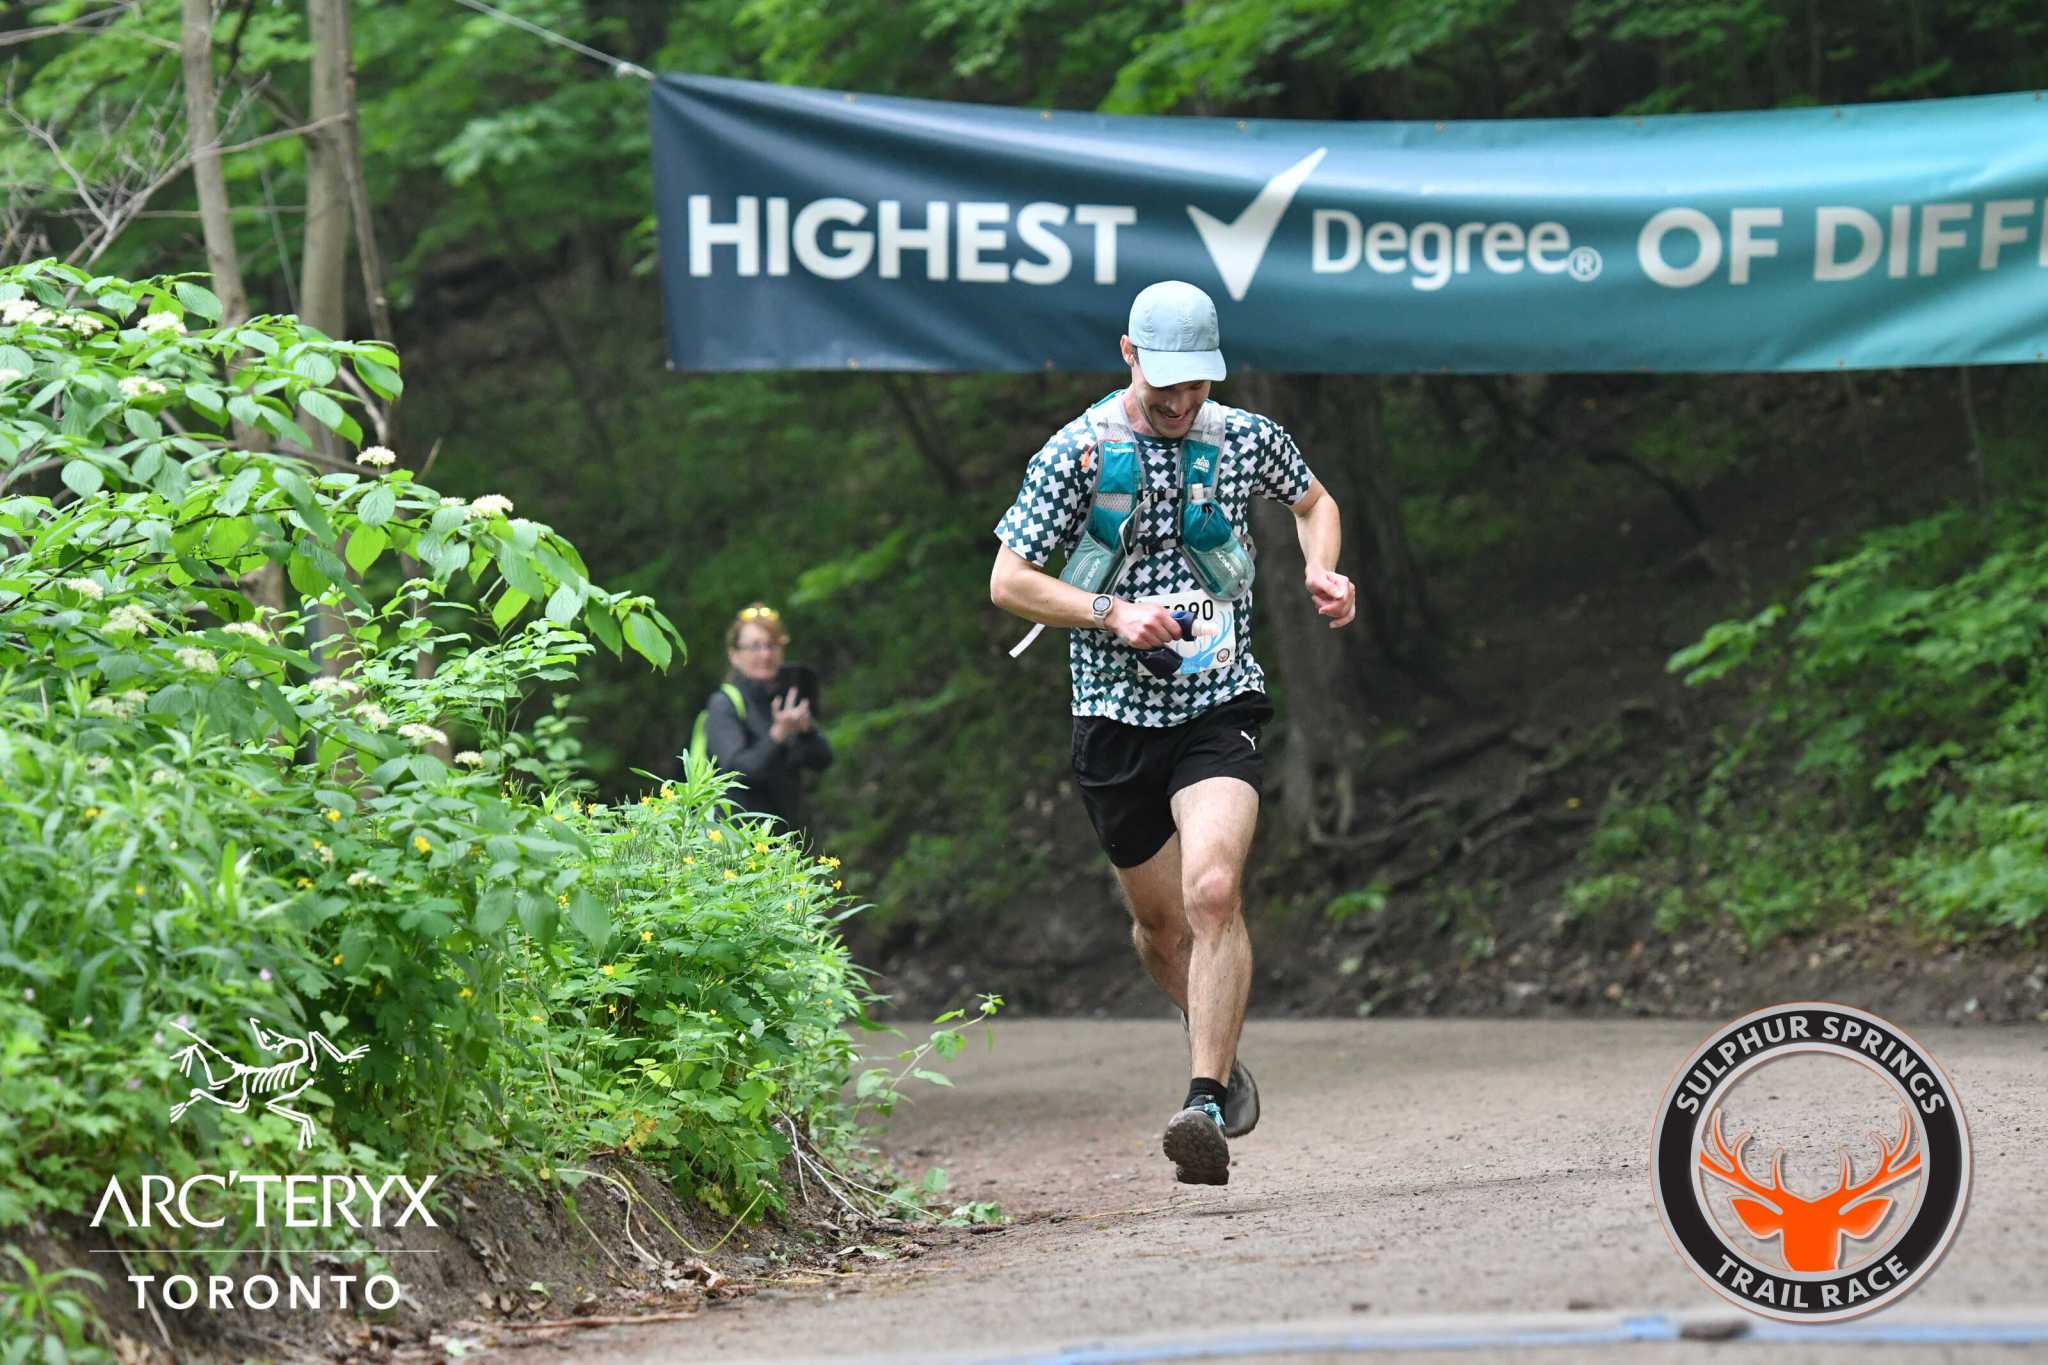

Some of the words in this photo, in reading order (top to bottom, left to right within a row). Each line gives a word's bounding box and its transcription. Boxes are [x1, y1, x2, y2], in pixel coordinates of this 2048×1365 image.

[688, 195, 1137, 286] HIGHEST
[1637, 206, 1783, 288] OF
[1813, 197, 2048, 282] DIFF
